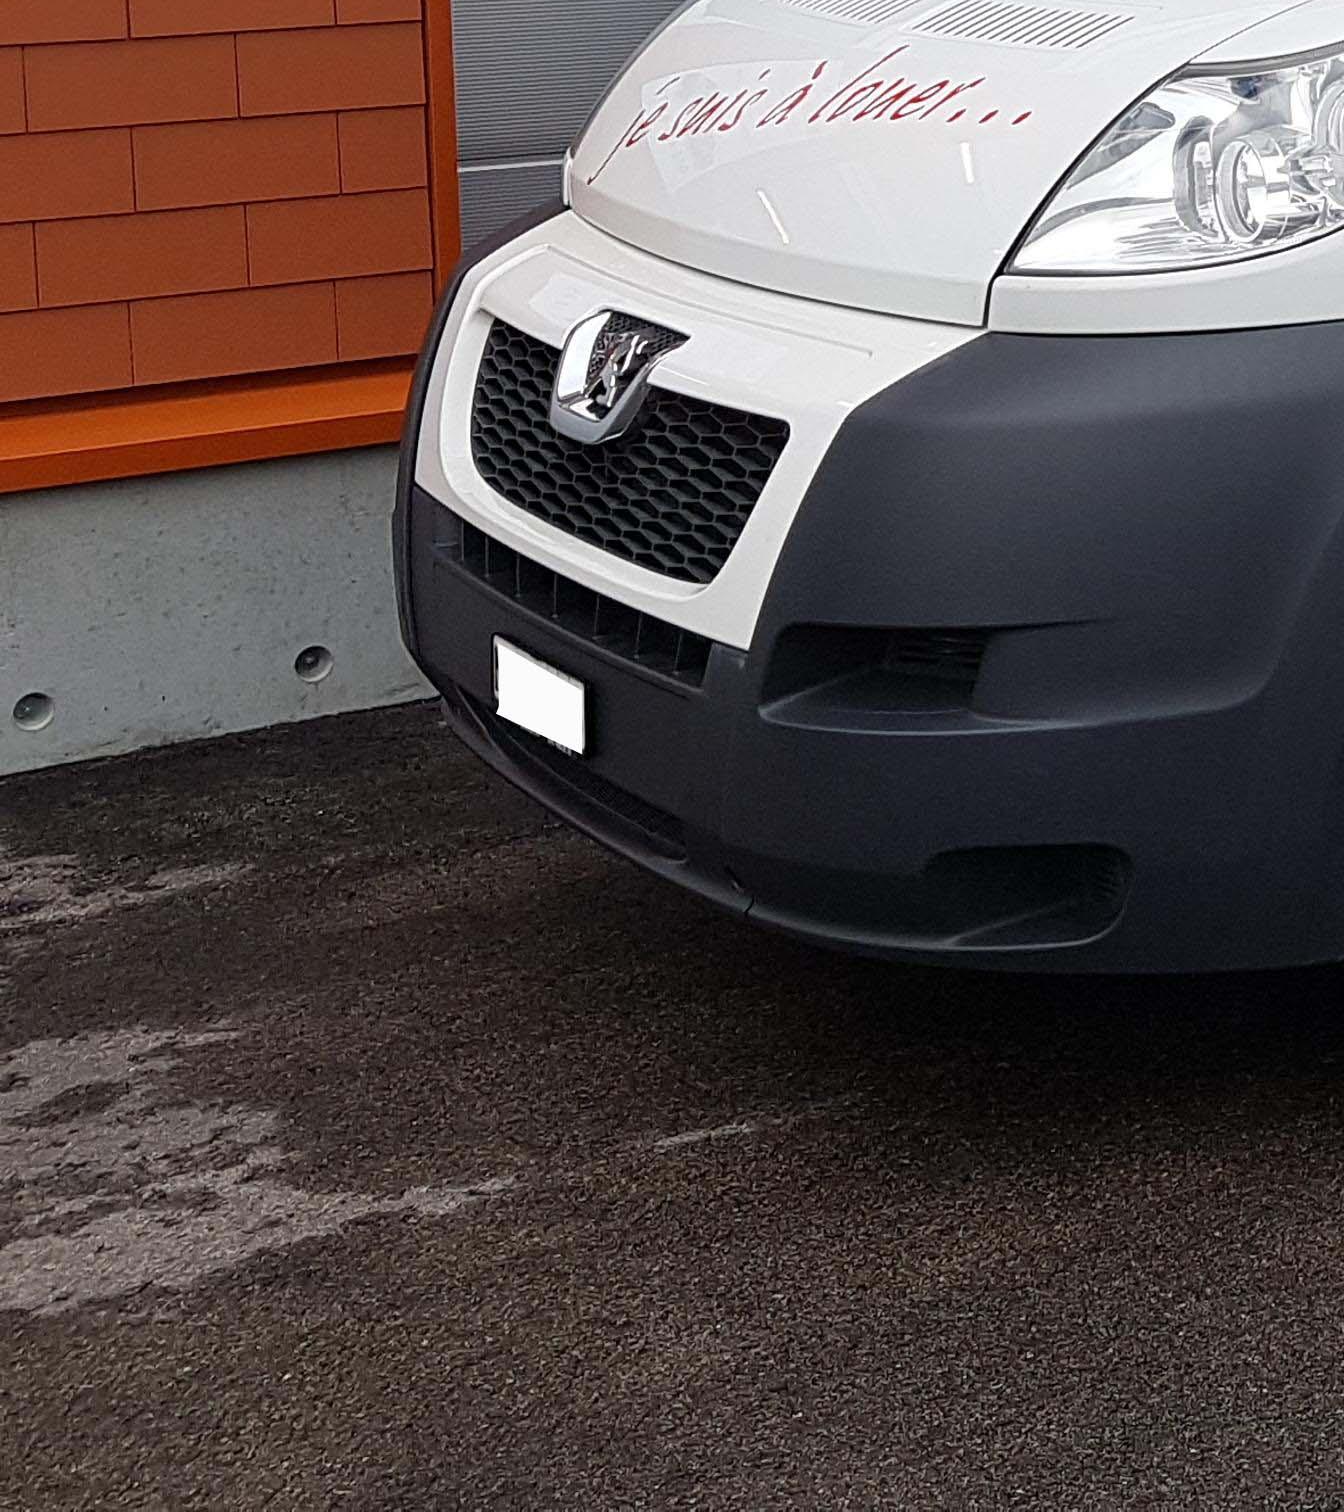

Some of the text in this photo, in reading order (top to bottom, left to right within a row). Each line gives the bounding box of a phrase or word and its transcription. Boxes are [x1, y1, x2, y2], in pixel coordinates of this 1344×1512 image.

[587, 76, 681, 185] je
[658, 69, 772, 141] suis
[755, 60, 828, 128] à
